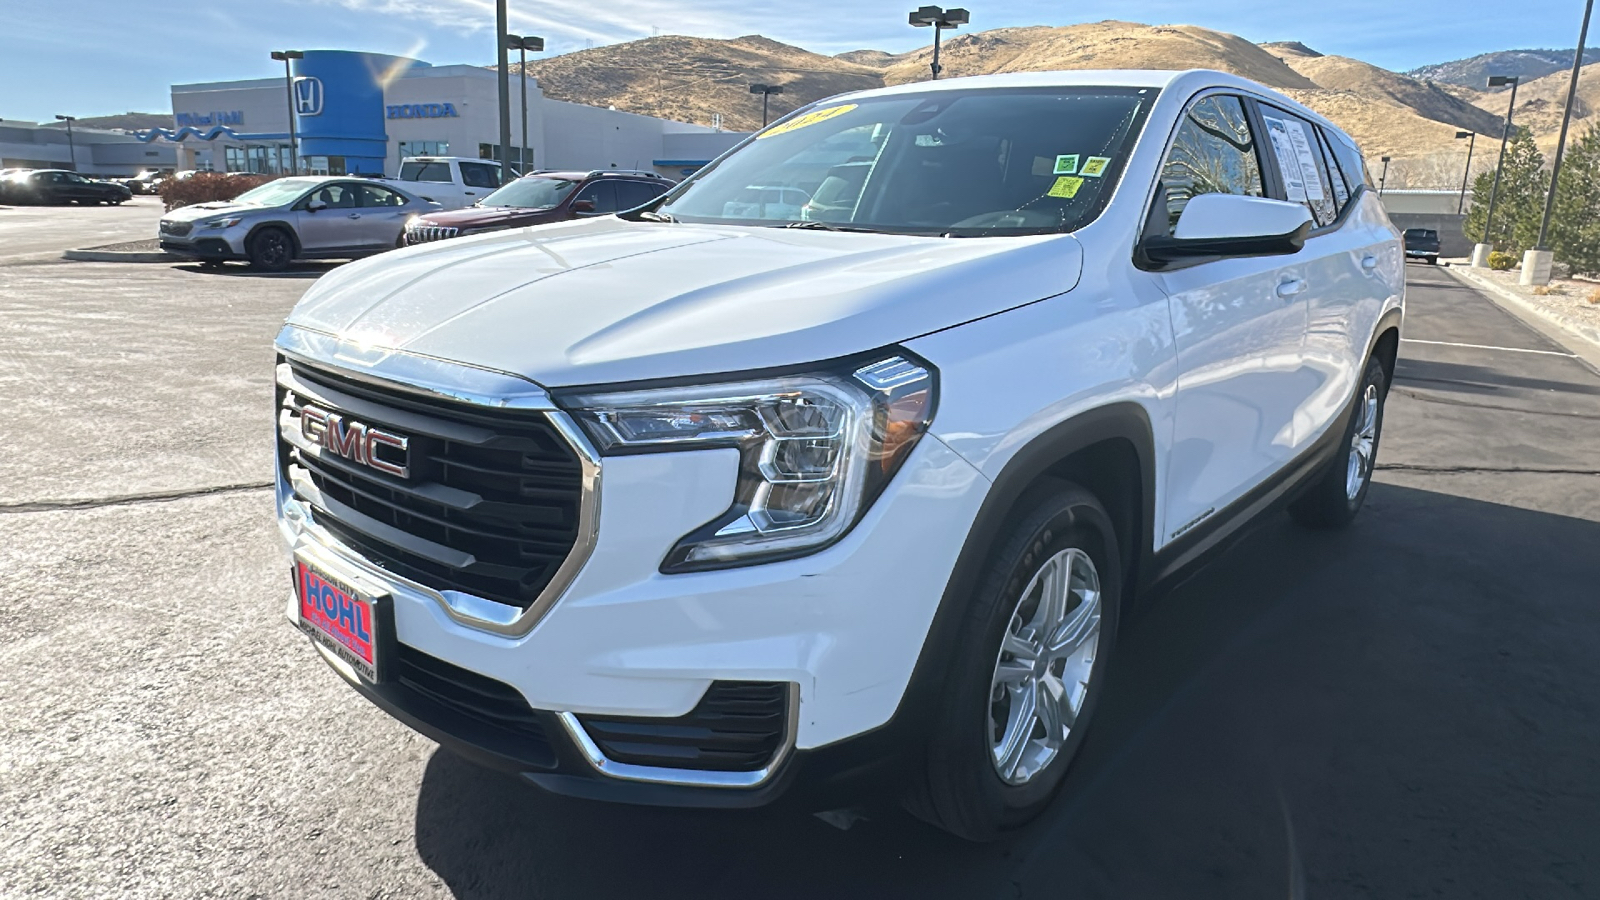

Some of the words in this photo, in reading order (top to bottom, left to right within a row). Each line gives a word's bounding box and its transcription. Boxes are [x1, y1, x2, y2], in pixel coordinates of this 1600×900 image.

[386, 103, 459, 119] HONDA
[301, 405, 410, 479] GMC
[304, 572, 371, 645] HOHL
[338, 647, 375, 680] AUTOMOTIVE
